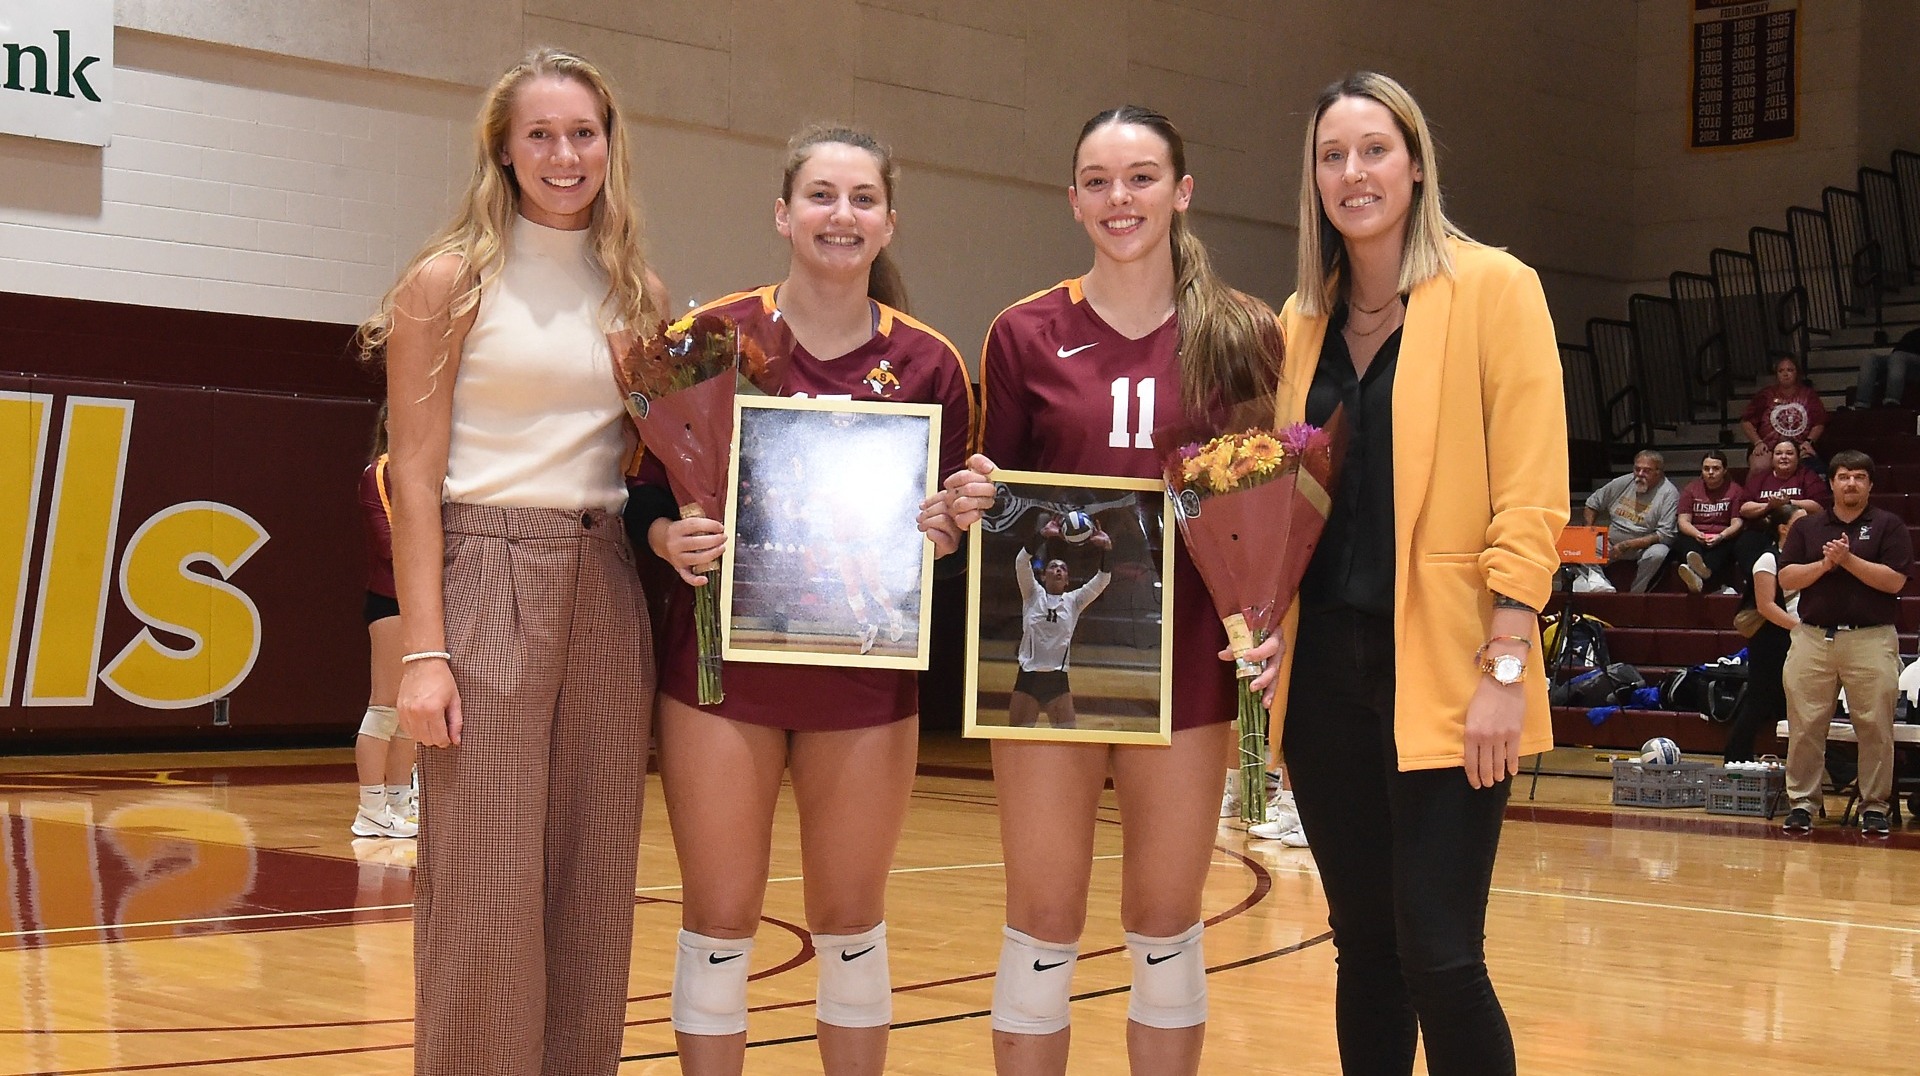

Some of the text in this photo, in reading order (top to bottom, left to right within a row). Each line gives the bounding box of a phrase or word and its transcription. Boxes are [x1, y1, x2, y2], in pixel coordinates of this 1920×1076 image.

[1767, 13, 1790, 27] 1995
[1733, 32, 1755, 46] 1997
[1732, 45, 1756, 60] 2000
[0, 30, 102, 102] nk
[1732, 59, 1756, 73] 2003
[1732, 73, 1756, 86] 2006
[1732, 86, 1756, 100] 2009
[1767, 81, 1786, 95] 2011
[1765, 94, 1788, 109] 2015
[1763, 108, 1788, 122] 2019
[1699, 127, 1755, 143] 2021 2022
[880, 373, 887, 382] S
[1109, 377, 1156, 449] 11
